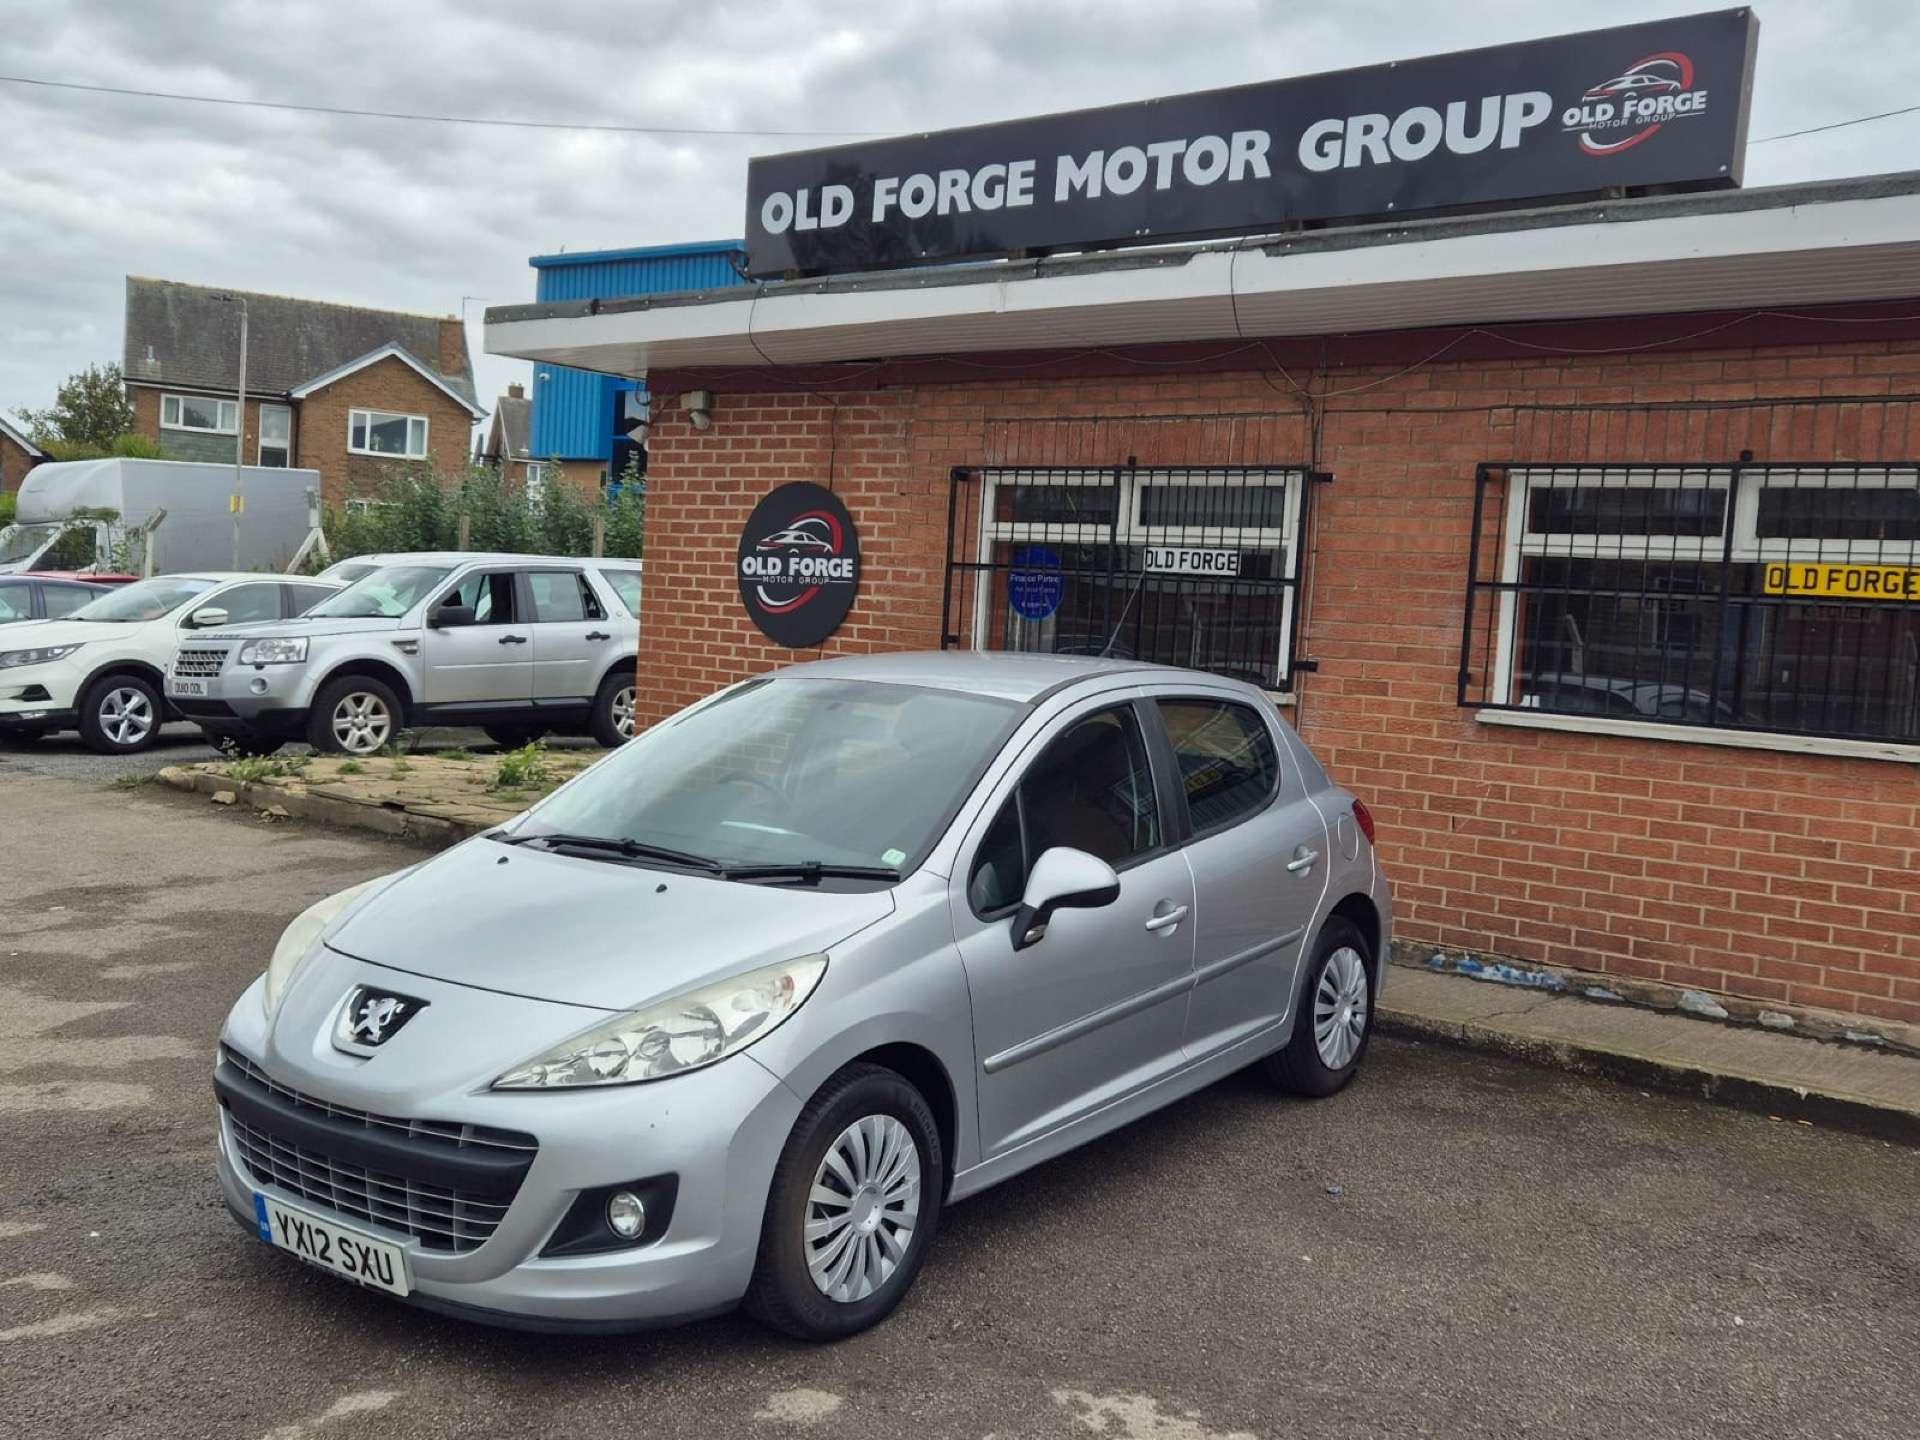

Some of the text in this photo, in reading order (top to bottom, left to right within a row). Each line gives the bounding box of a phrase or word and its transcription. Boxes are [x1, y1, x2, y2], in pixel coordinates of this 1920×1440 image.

[1562, 90, 1708, 126] OLD FORGE
[1588, 113, 1676, 130] MOTOR GROUP
[761, 91, 1553, 235] OLD FORGE MOTOR GROUP
[742, 556, 853, 578] OLD FORGE
[1145, 550, 1238, 571] OLD FORGE
[762, 575, 830, 585] MOTOR GROUP
[1768, 567, 1920, 595] OLD FORGE
[275, 1210, 394, 1285] YX12 SXU
